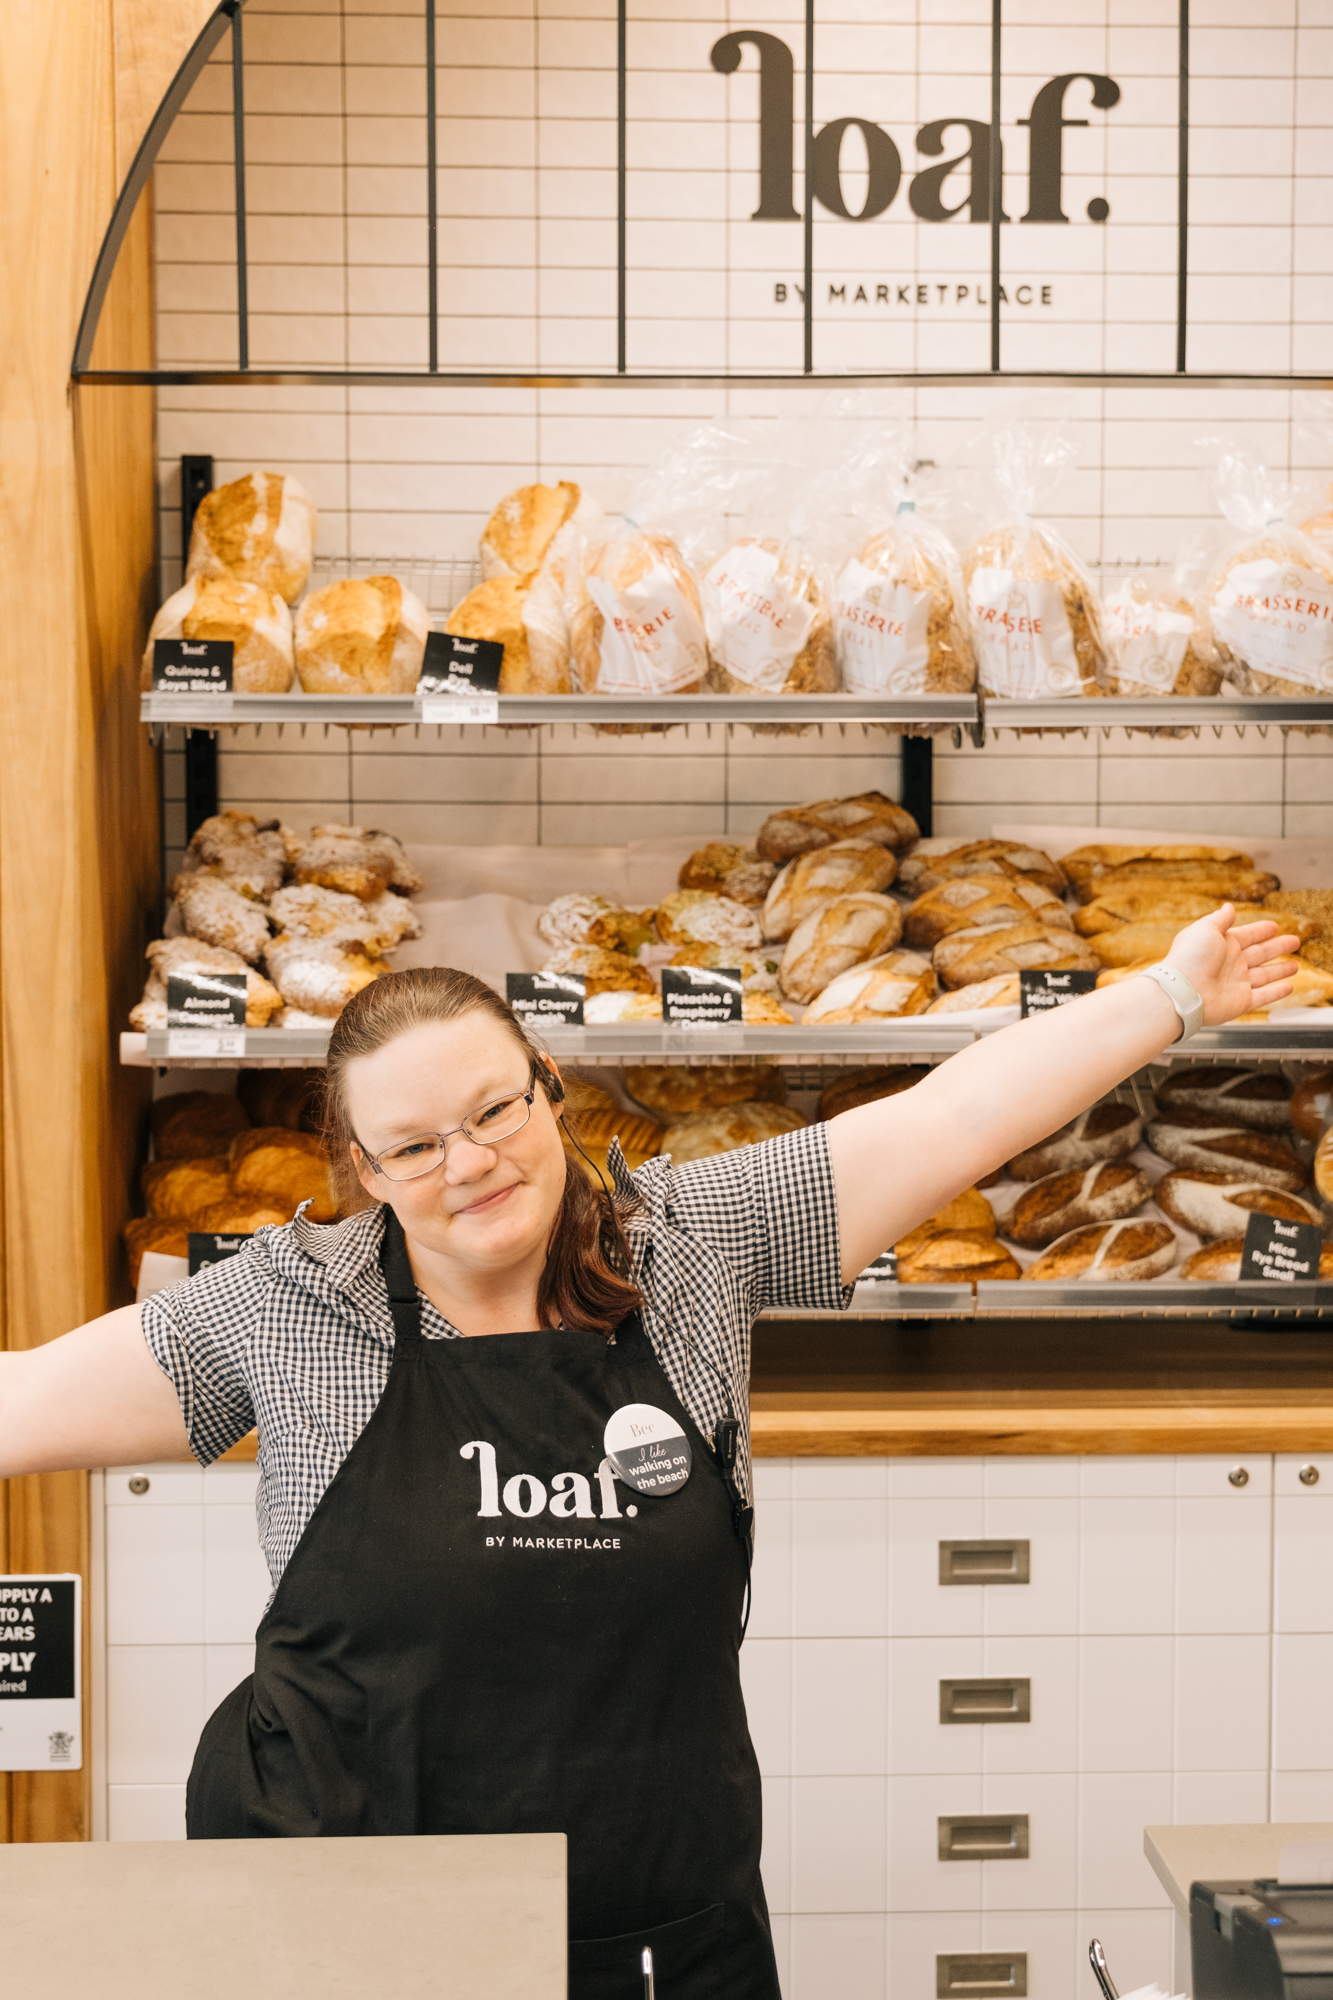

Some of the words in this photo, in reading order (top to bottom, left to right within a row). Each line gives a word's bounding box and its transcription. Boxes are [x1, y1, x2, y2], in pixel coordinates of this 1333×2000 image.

[710, 30, 1121, 224] loaf.
[774, 283, 806, 305] BY
[828, 284, 1053, 306] MARKETPLACE
[1233, 593, 1333, 623] BRASSERI
[164, 664, 210, 677] Quinoa
[210, 665, 221, 677] &
[448, 660, 474, 675] Deli
[157, 678, 189, 692] Soya
[189, 678, 227, 692] Sliced
[183, 996, 231, 1009] Almond
[511, 999, 537, 1011] Mini
[537, 998, 579, 1013] Cherry
[666, 992, 722, 1006] Pistachio
[722, 992, 733, 1005] &
[1026, 993, 1055, 1005] Mica
[669, 1005, 731, 1021] Raspberry
[1268, 1240, 1297, 1258] Mica
[1251, 1249, 1274, 1266] Rye
[1274, 1254, 1310, 1274] Bread
[1261, 1265, 1295, 1282] Small
[649, 1443, 667, 1459] like
[628, 1458, 672, 1476] walking
[672, 1455, 687, 1466] on
[459, 1440, 639, 1519] loaf.
[636, 1477, 656, 1490] the
[656, 1468, 689, 1485] beach
[485, 1536, 506, 1548] BY
[512, 1536, 621, 1550] MARKETPLACE
[0, 1588, 39, 1604] PPLY
[39, 1588, 53, 1604] A
[21, 1607, 34, 1623] A
